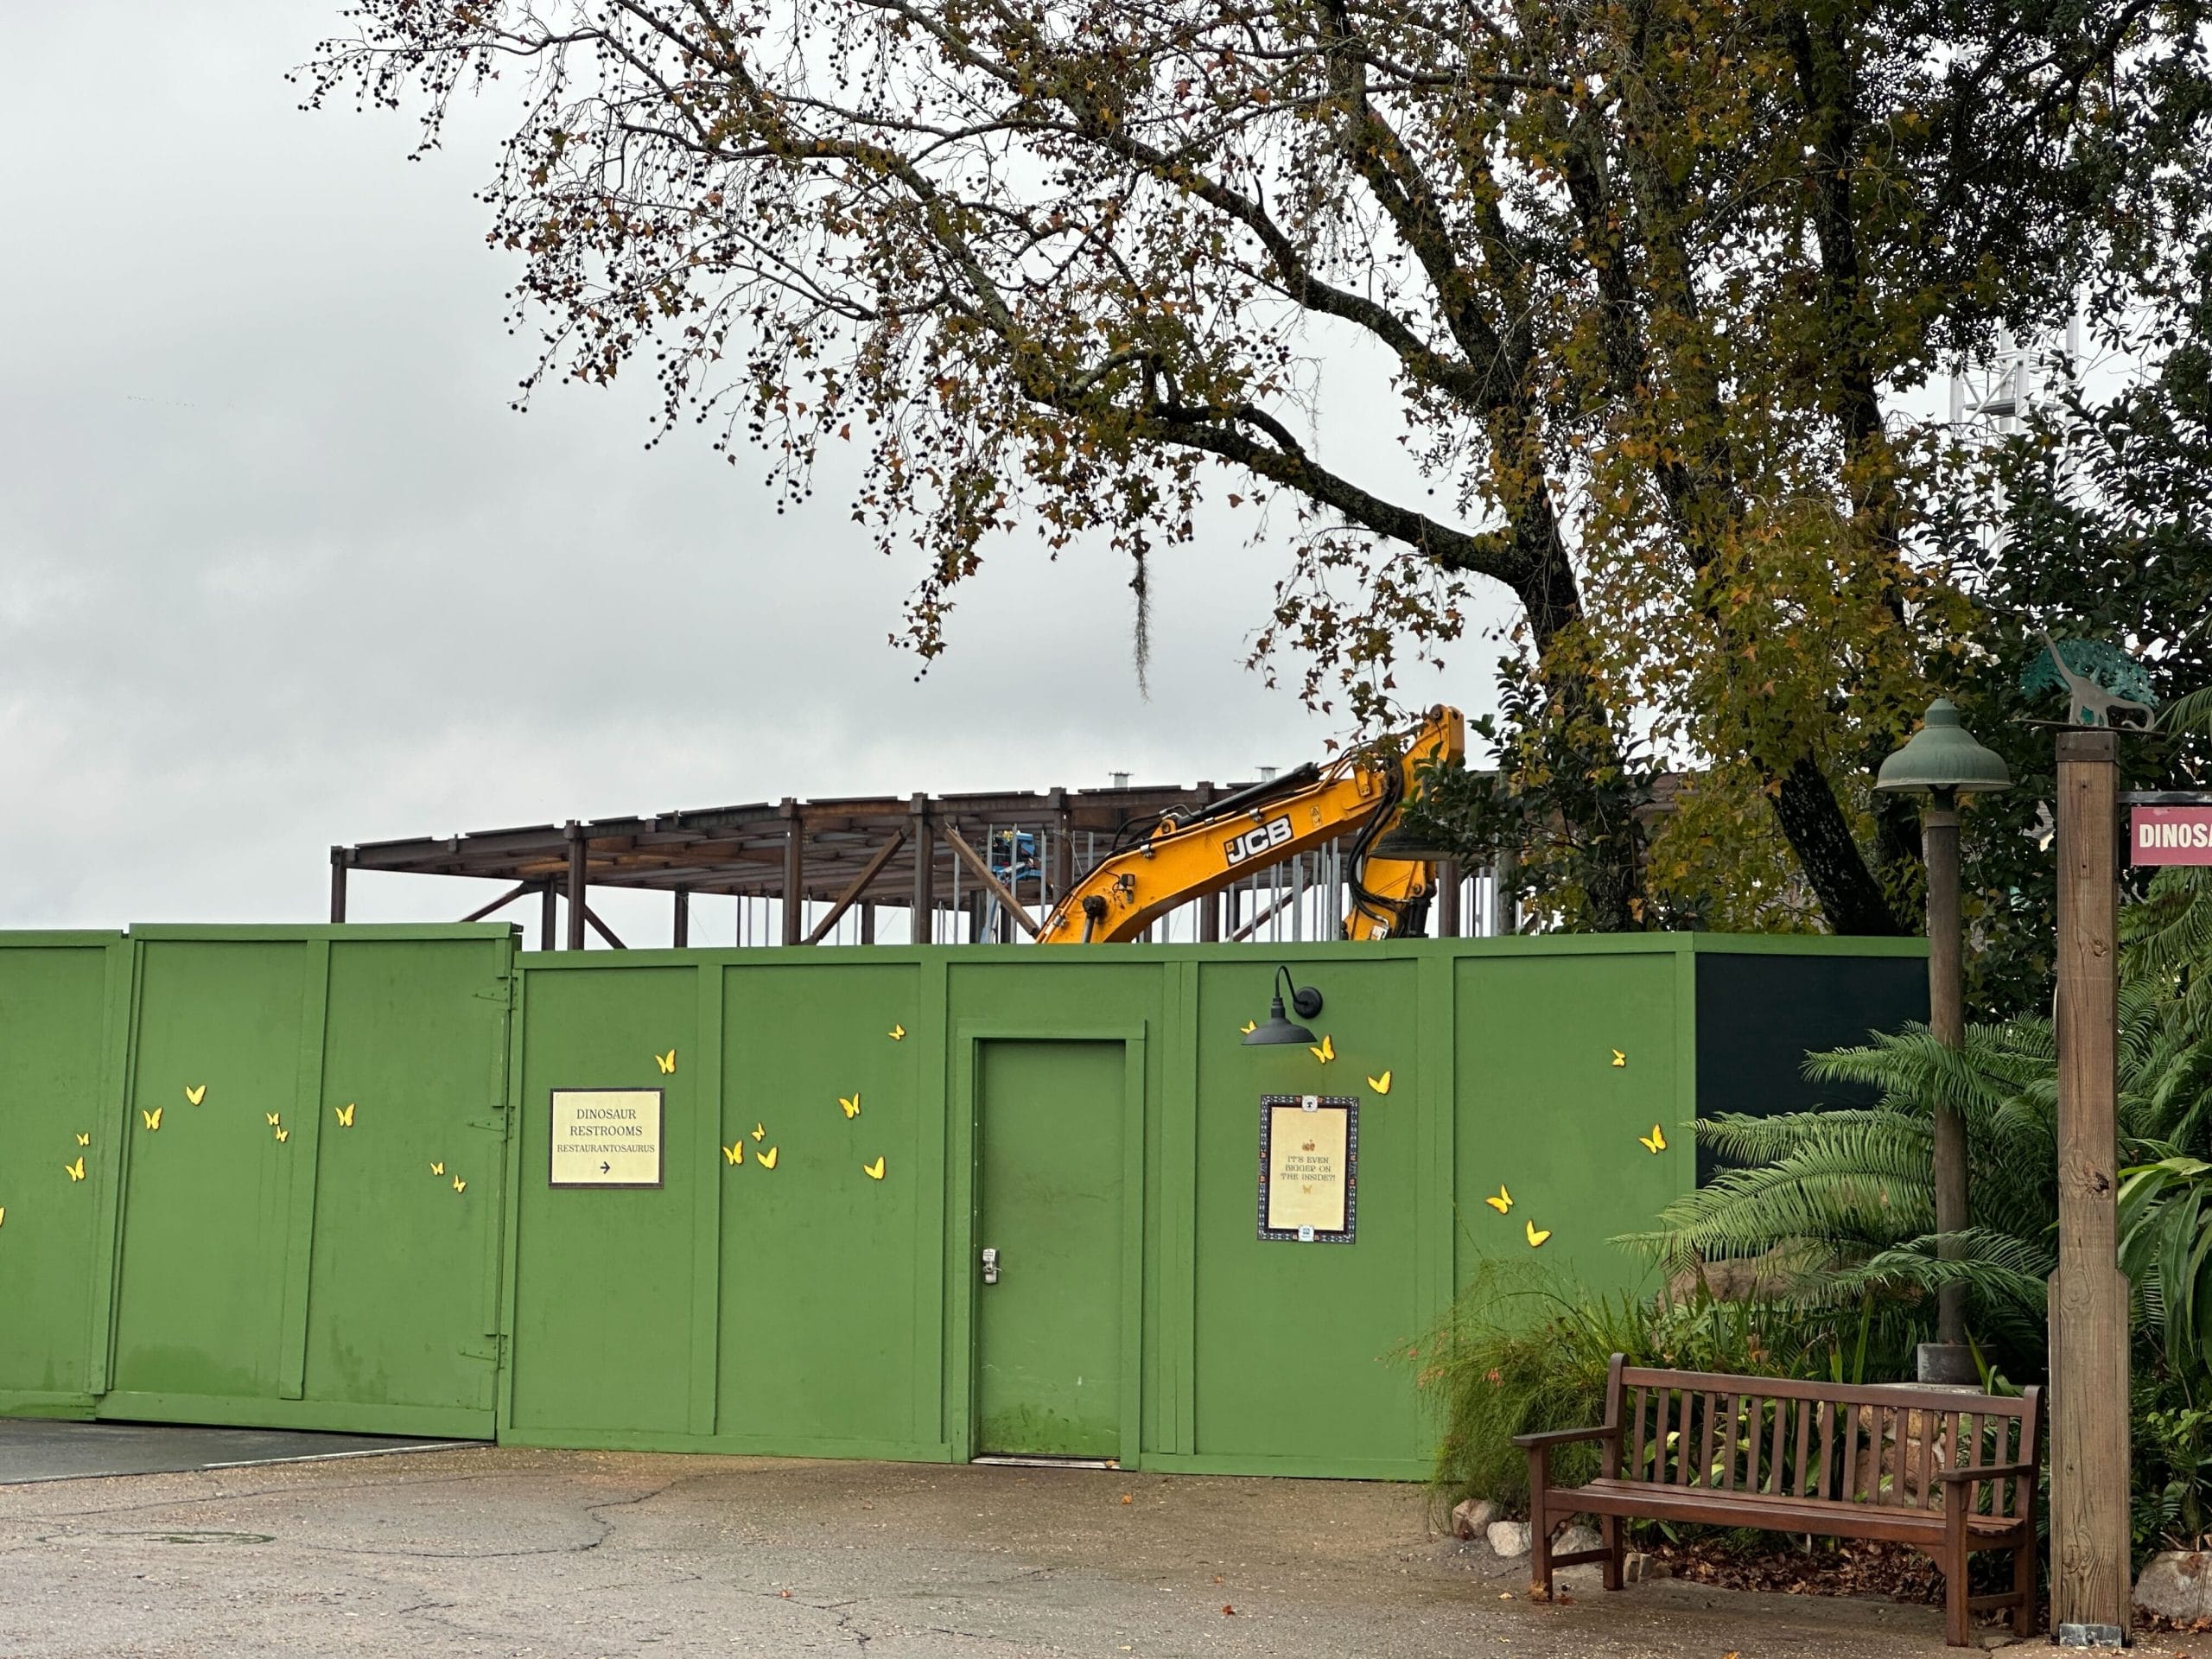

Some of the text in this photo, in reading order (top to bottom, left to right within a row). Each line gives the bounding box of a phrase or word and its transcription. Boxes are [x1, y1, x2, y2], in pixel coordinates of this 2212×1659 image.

[1226, 817, 1293, 863] JCB
[2139, 823, 2212, 848] DINOS
[576, 1109, 637, 1119] DINOSAUR
[570, 1125, 643, 1136] RESTROOMS
[557, 1144, 655, 1153] RESTAURANTOSAURUS
